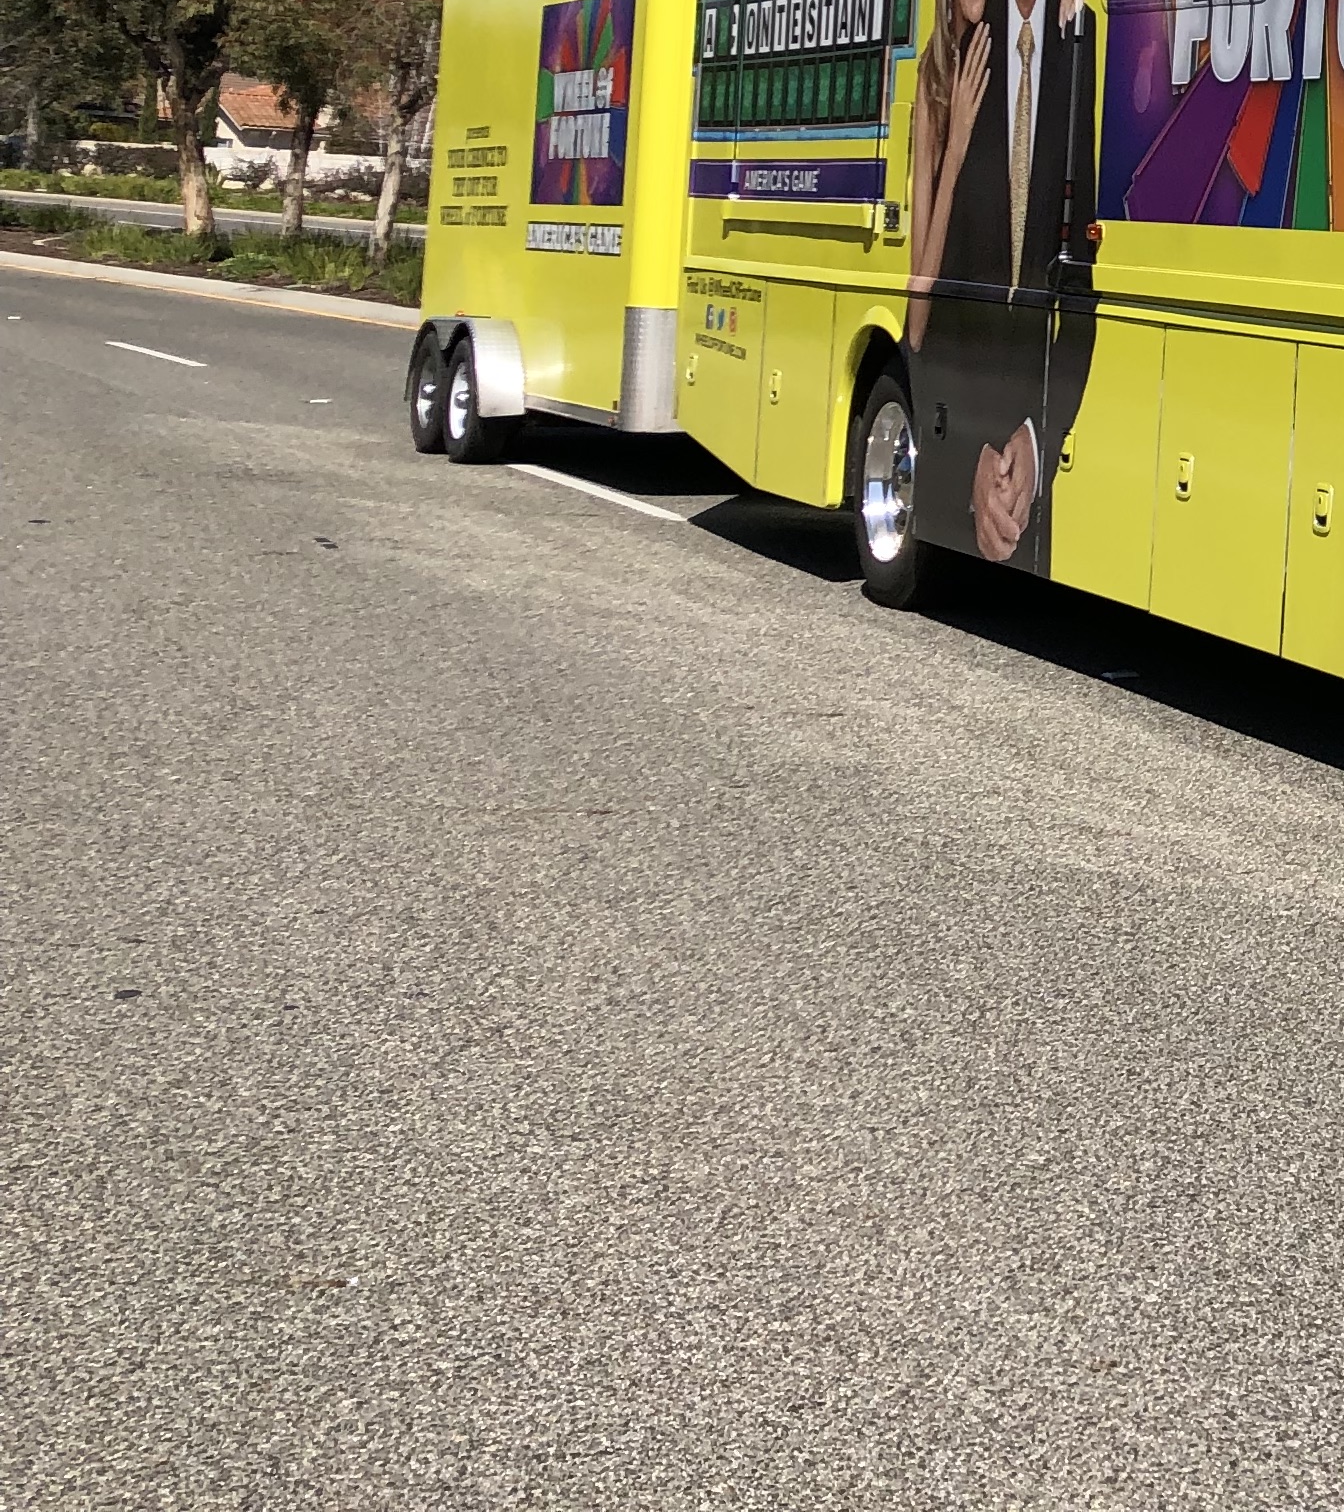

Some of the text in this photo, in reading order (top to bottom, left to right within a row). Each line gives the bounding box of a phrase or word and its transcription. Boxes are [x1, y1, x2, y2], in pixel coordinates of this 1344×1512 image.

[704, 9, 717, 58] A
[554, 70, 595, 113] WHEEL
[548, 113, 611, 160] FORTUNE
[744, 170, 819, 192] AMERICA'S GAME
[525, 220, 623, 256] AMERICA'S GAME
